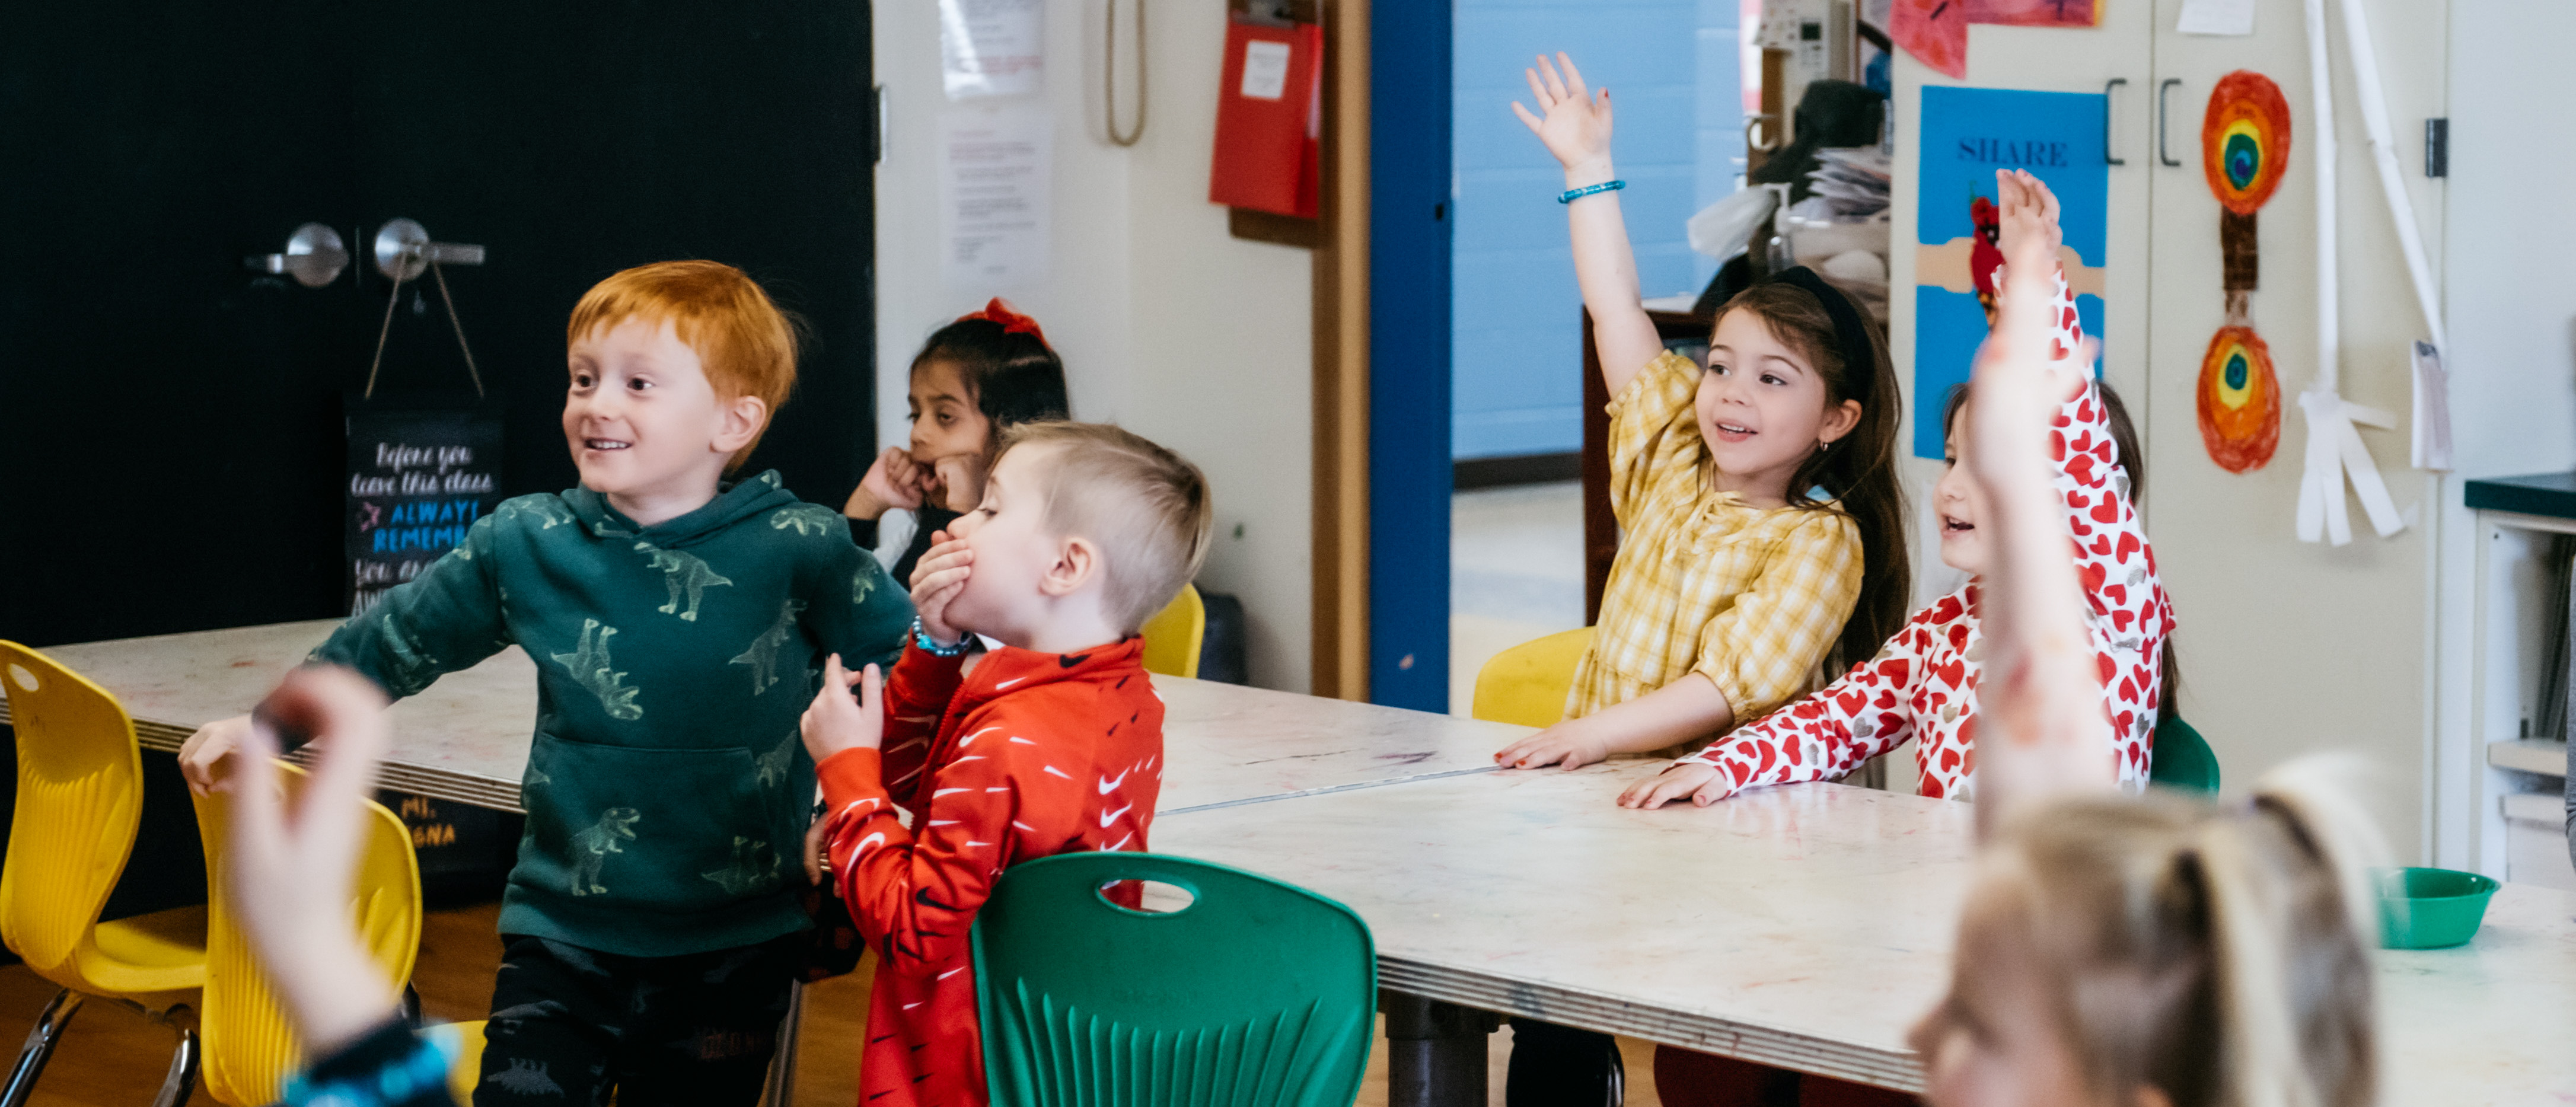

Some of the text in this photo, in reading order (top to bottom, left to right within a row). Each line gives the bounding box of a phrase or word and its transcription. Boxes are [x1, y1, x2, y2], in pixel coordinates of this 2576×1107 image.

[1959, 138, 2068, 168] SHARE
[376, 442, 473, 474] Before you
[373, 525, 467, 553] REMEMB
